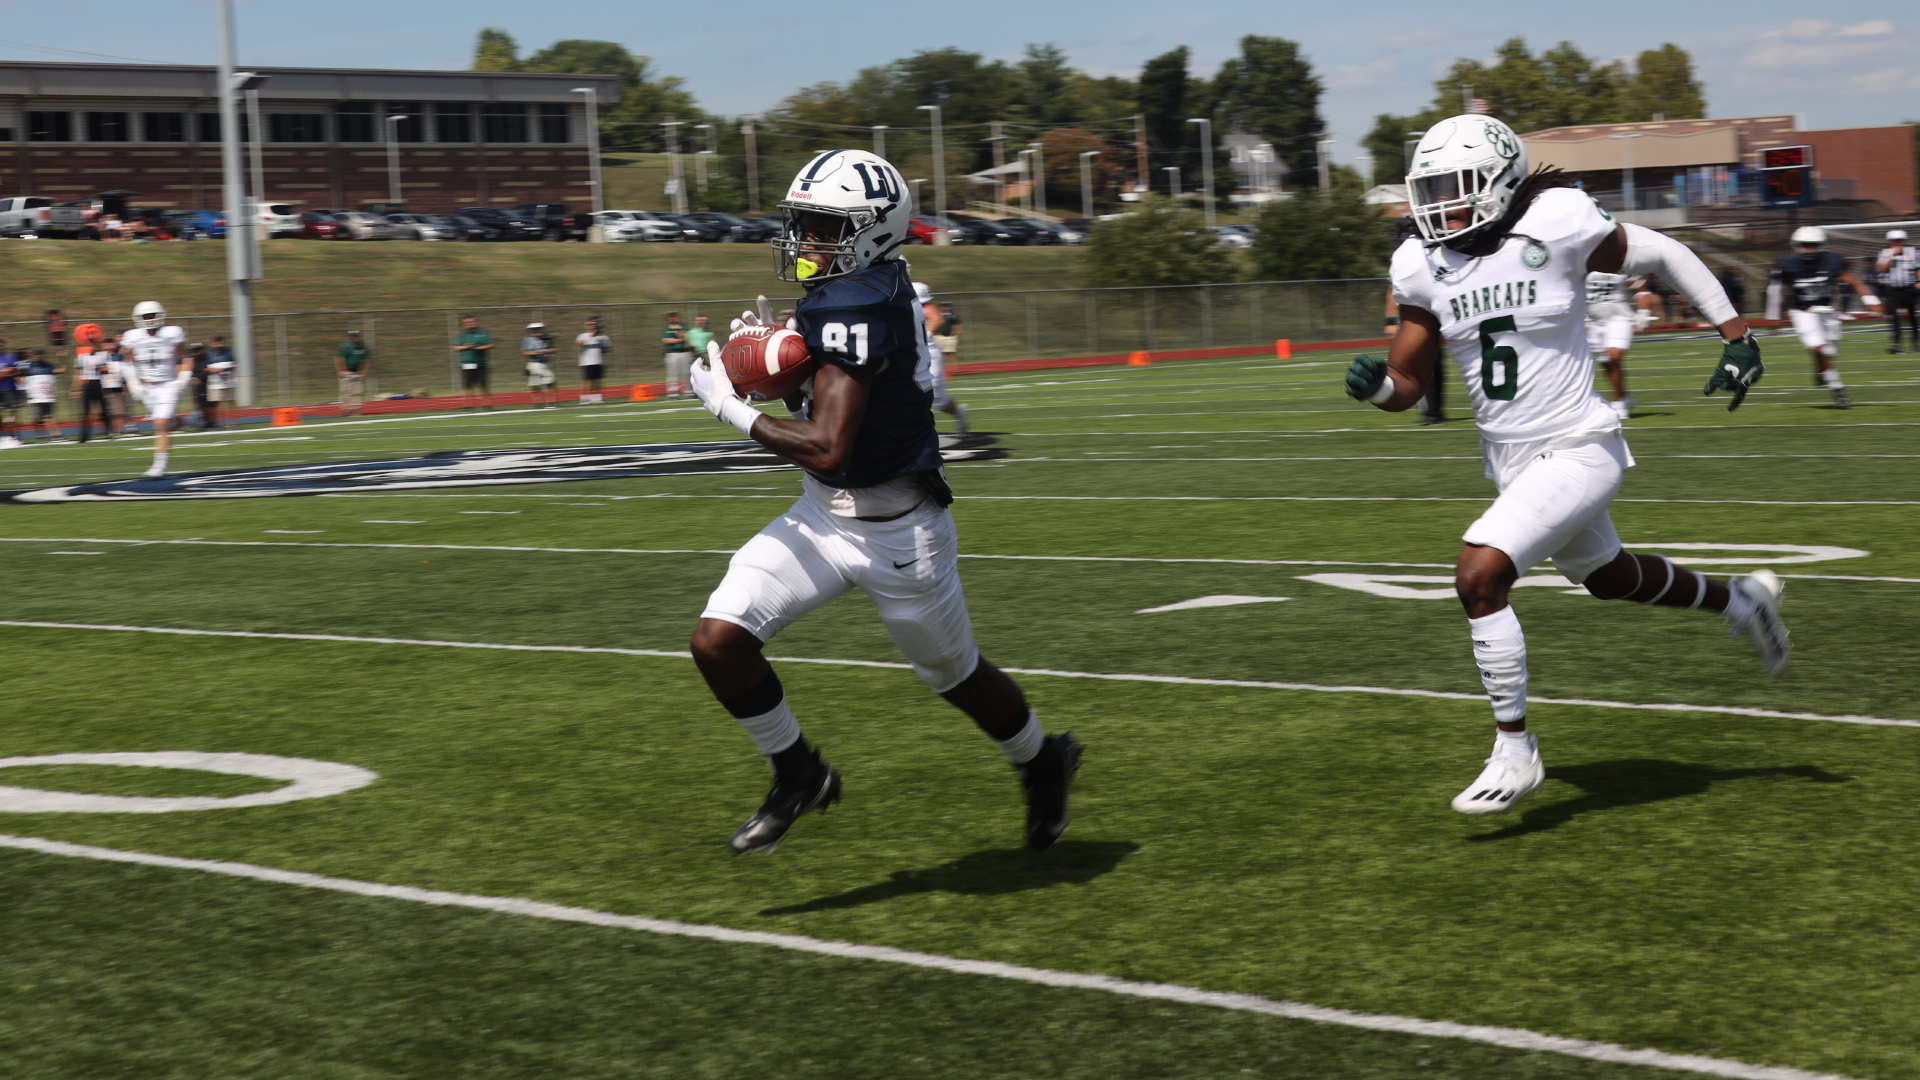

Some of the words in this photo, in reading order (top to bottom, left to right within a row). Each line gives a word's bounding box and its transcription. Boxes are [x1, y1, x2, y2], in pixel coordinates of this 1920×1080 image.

[791, 190, 813, 200] Riddell
[1449, 280, 1537, 323] BEARCATS
[822, 322, 868, 366] 81
[1479, 315, 1518, 401] 6
